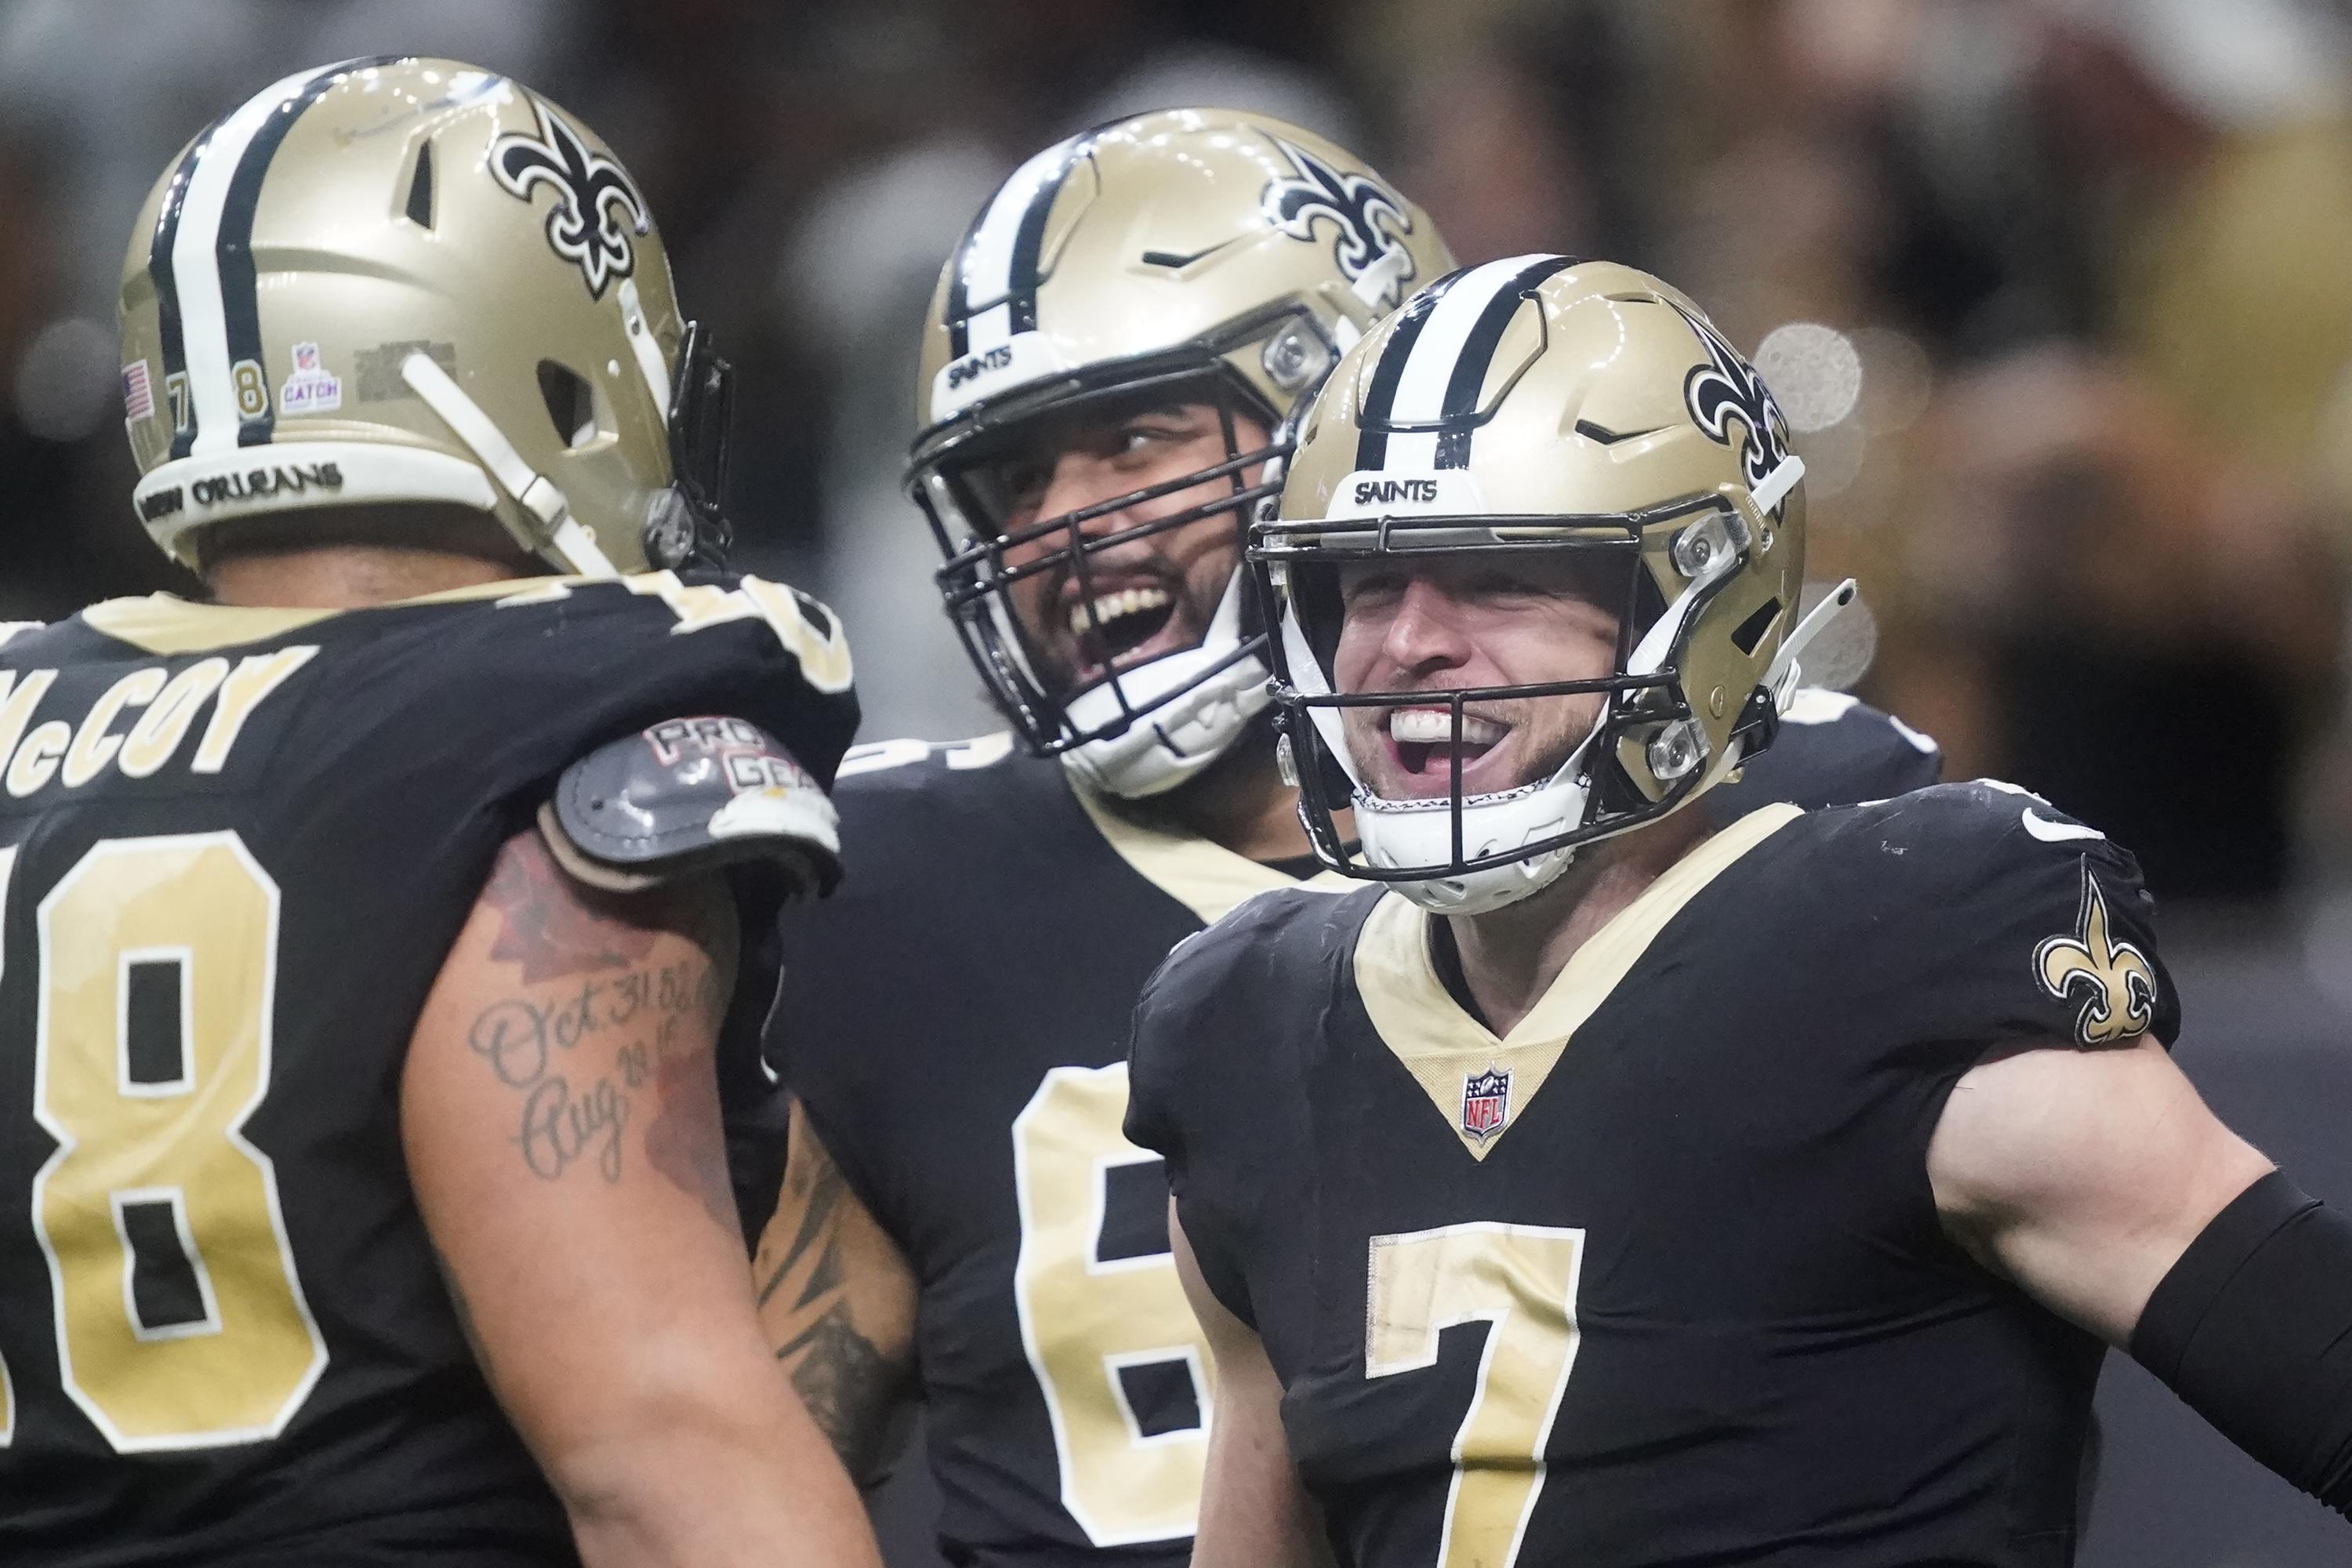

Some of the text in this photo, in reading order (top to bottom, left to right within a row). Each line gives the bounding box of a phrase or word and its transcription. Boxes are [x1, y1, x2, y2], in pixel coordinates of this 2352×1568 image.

[165, 358, 270, 432] 7 8
[284, 381, 337, 403] CATCH
[1354, 479, 1438, 504] SAINTS
[0, 829, 329, 1454] 8
[1467, 1098, 1500, 1129] NFL
[1012, 1060, 1218, 1548] 6
[1366, 1221, 1586, 1568] 7
